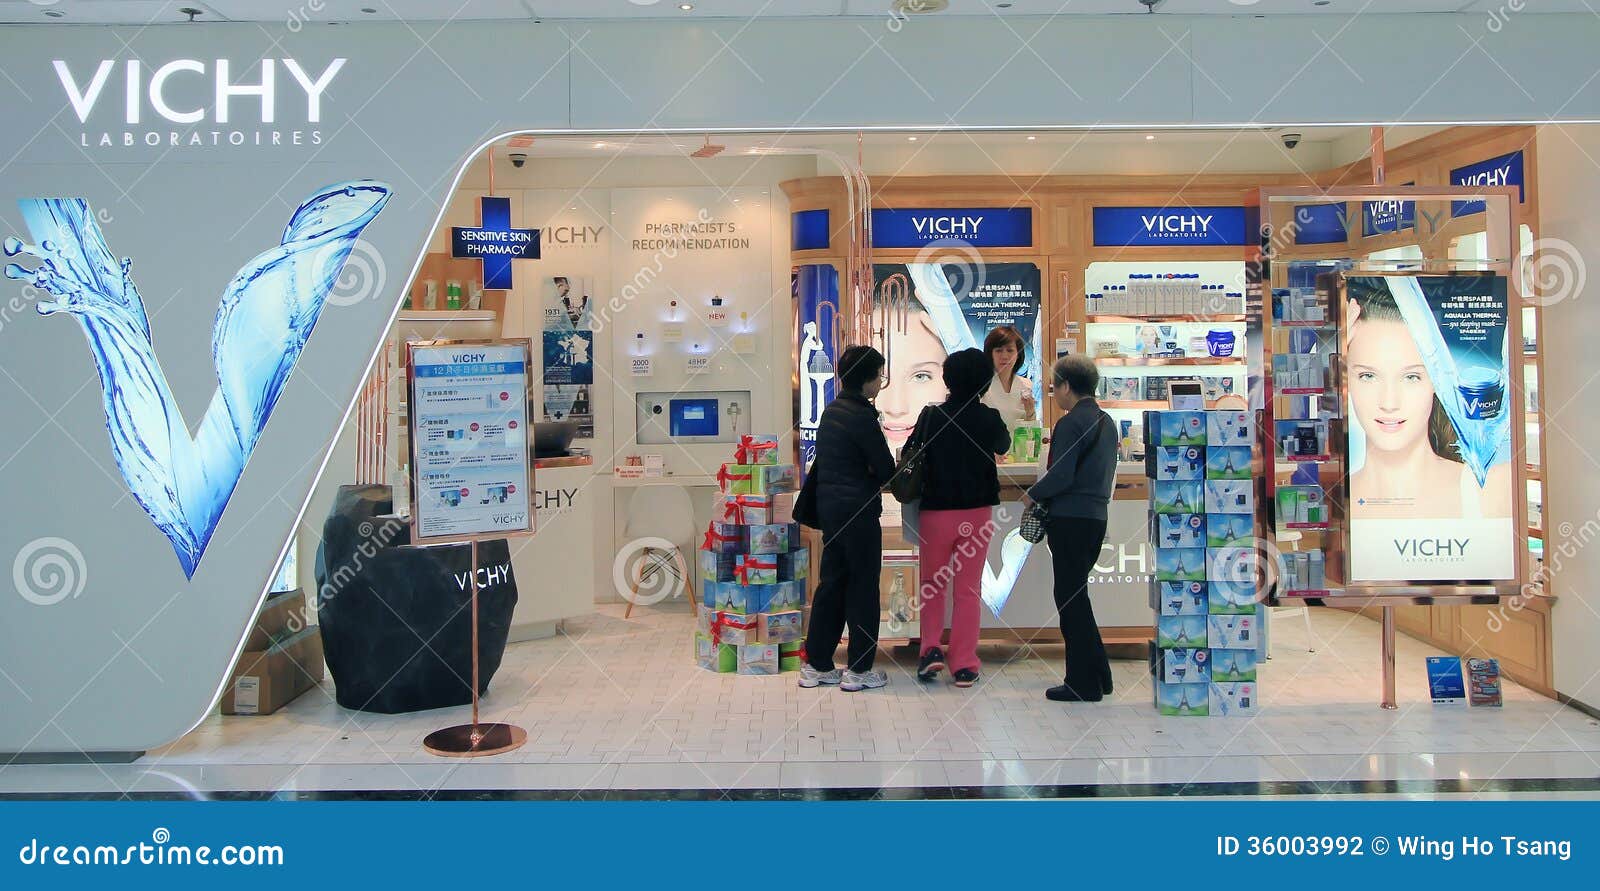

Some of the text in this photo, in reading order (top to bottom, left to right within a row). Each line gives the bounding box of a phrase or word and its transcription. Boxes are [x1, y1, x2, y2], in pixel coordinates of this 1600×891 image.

[52, 58, 348, 124] VICHY
[81, 130, 323, 147] LABORATOIRES
[645, 222, 737, 234] PHARMACIST'S
[912, 216, 984, 234] VICHY
[1141, 215, 1213, 232] VICHY
[1336, 209, 1445, 236] VICHY
[461, 230, 532, 242] SENSITIVE SKIN
[467, 244, 527, 256] PHARMACY
[632, 238, 751, 250] RECOMMENDATION
[545, 308, 560, 316] 1931
[452, 353, 486, 363] VICHY
[493, 515, 525, 524] VICHY
[1393, 538, 1470, 556] VICHY
[454, 564, 509, 591] VICHY
